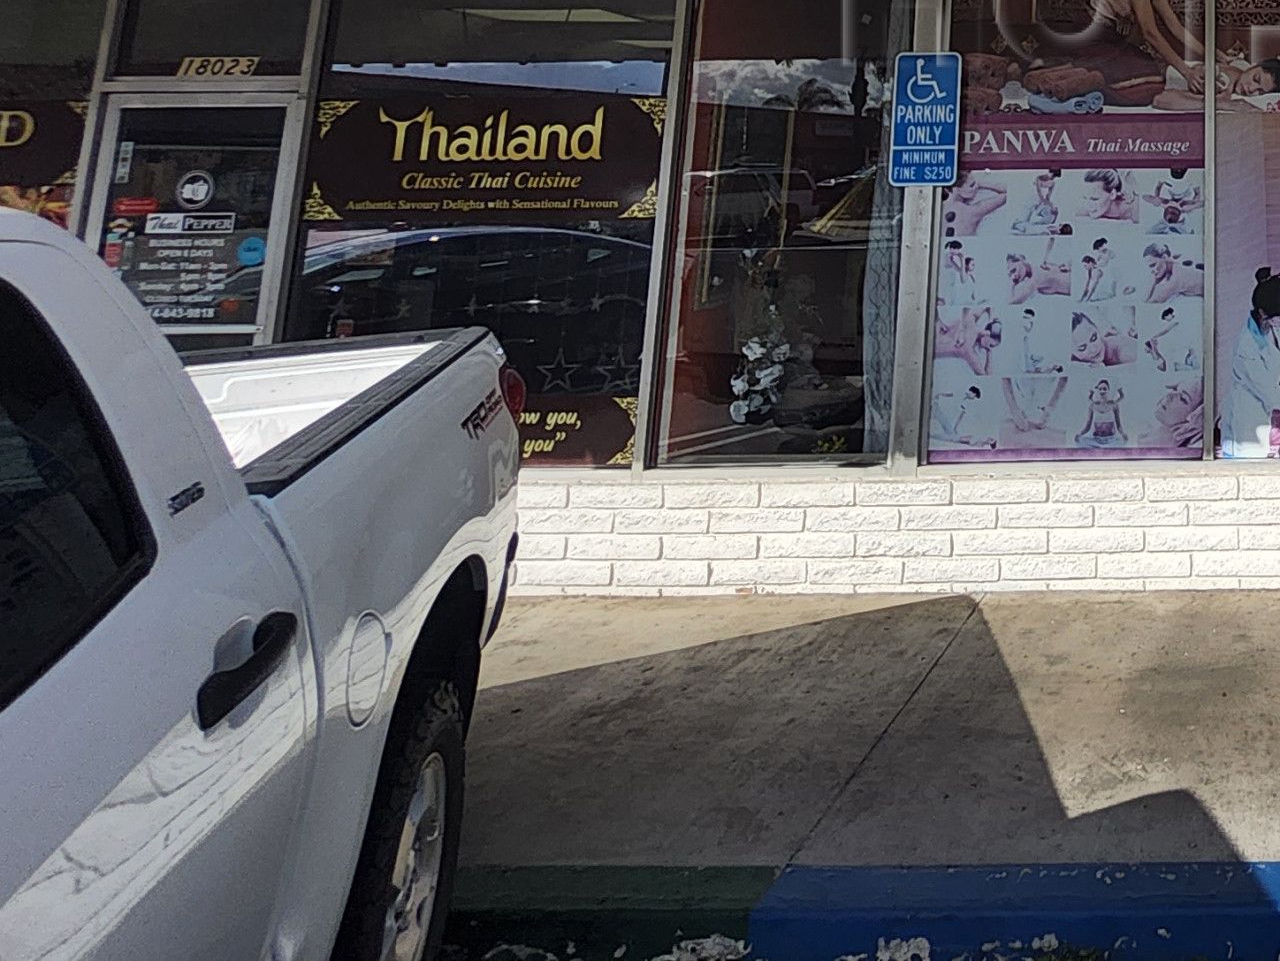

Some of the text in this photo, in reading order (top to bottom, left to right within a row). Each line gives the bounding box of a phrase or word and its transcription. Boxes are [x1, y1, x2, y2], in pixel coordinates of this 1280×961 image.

[183, 59, 256, 76] 18023
[897, 105, 954, 124] PARKING
[379, 106, 605, 162] Thailand
[906, 126, 943, 145] ONLY
[963, 130, 1190, 156] PANWA Thai Massage
[902, 151, 945, 163] MINIMUM
[402, 172, 582, 189] Classic Thai Cuisine
[893, 167, 916, 180] FINE
[346, 198, 619, 212] Authentic Savoury Delights with Sensational Flavours
[184, 218, 232, 230] PEPPER
[461, 401, 489, 440] TRD
[545, 412, 582, 430] you,
